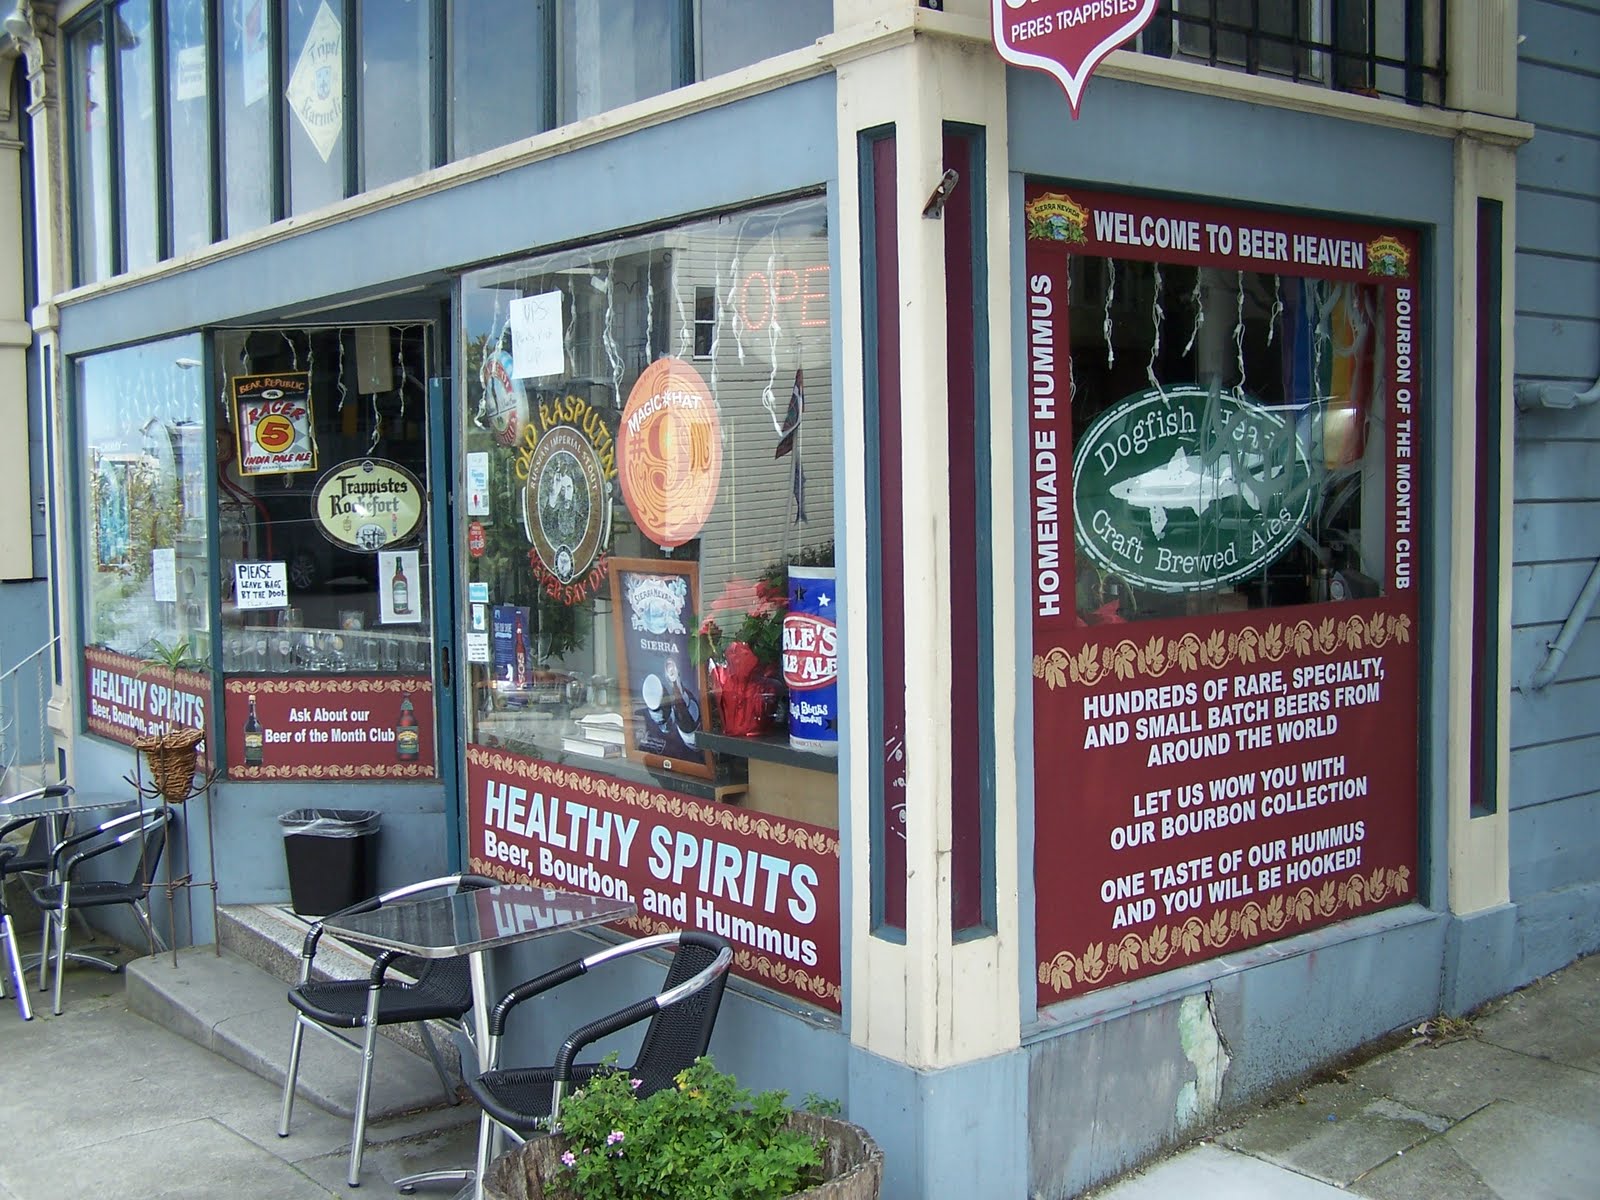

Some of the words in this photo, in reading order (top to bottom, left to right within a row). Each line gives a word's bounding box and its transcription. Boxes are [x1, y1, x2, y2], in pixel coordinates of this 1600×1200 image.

[1011, 15, 1053, 43] PERES
[1056, 0, 1137, 30] TRAPPISTES
[1034, 203, 1056, 213] SIERRA
[1056, 203, 1080, 218] NEVADA
[1093, 210, 1201, 252] WELCOME
[1205, 223, 1233, 255] TO
[1238, 227, 1288, 262] BEER
[1293, 234, 1364, 270] HEAVEN
[1031, 274, 1055, 420] HUMMUS
[1396, 288, 1411, 384] BOURBON
[239, 380, 262, 394] BEAR
[264, 378, 306, 391] REPUBLIC
[248, 400, 306, 425] RACER
[1396, 388, 1411, 414] OF
[261, 421, 290, 446] 5
[516, 423, 538, 480] OLD
[539, 395, 618, 481] RASPUTIN
[627, 394, 662, 438] MAGIC
[671, 391, 703, 410] HAT
[1095, 405, 1197, 476] Dogfish
[1396, 419, 1411, 458] THE
[244, 455, 270, 466] INDIA
[272, 453, 294, 463] PALE
[295, 452, 311, 461] ALE
[550, 435, 581, 453] IMPERIAL
[581, 451, 598, 490] STOUT
[334, 474, 408, 501] Trappistes
[1396, 464, 1411, 533] MONTH
[1035, 430, 1060, 617] HOMEMADE
[1092, 509, 1144, 565] Craft
[1155, 542, 1239, 574] Brewed
[1250, 506, 1292, 555] Ales
[241, 580, 262, 589] LEAVE
[1395, 538, 1410, 590] CLUB
[241, 590, 251, 599] BY
[252, 590, 265, 599] THE
[640, 638, 680, 654] SIERRA
[801, 656, 838, 680] ALE
[91, 667, 147, 711] HEALTHY
[150, 683, 205, 730] SPIRITS
[1083, 682, 1198, 720] HUNDREDS
[1203, 678, 1228, 702] OF
[1234, 671, 1288, 697] RARE,
[1292, 656, 1385, 689] SPECIALTY,
[91, 699, 112, 723] Beer,
[112, 705, 147, 736] Bourbon,
[265, 729, 292, 743] Beer
[294, 728, 306, 743] of
[309, 728, 328, 743] the
[331, 728, 367, 743] Month
[369, 728, 396, 742] Club
[289, 708, 311, 723] Ask
[314, 708, 348, 722] About
[351, 710, 370, 722] our
[1083, 720, 1129, 750] AND
[1135, 709, 1203, 741] SMALL
[1207, 699, 1269, 730] BATCH
[1274, 689, 1330, 719] BEERS
[1334, 682, 1381, 709] FROM
[1147, 733, 1231, 768] AROUND
[1235, 725, 1272, 751] THE
[1277, 714, 1338, 744] WORLD
[1110, 820, 1156, 850] OUR
[1161, 799, 1256, 840] BOURBON
[1260, 775, 1368, 818] COLLECTION
[1133, 789, 1172, 818] LET
[1177, 783, 1204, 809] US
[1209, 773, 1256, 802] WOW
[1260, 764, 1297, 791] YOU
[1301, 755, 1345, 783] WITH
[484, 779, 640, 868] HEALTHY
[648, 825, 819, 925] SPIRITS
[1100, 872, 1145, 903] ONE
[1150, 856, 1213, 890] TASTE
[1218, 849, 1243, 872] OF
[1247, 839, 1287, 867] OUR
[1291, 820, 1366, 852] HUMMUS
[484, 829, 534, 877] Beer,
[539, 847, 635, 903] Bourbon,
[642, 886, 687, 924] and
[695, 896, 818, 967] Hummus
[1111, 898, 1156, 930] AND
[1161, 885, 1203, 916] YOU
[1207, 875, 1253, 904] WILL
[1258, 867, 1282, 892] BE
[1286, 845, 1362, 885] HOOKED!
